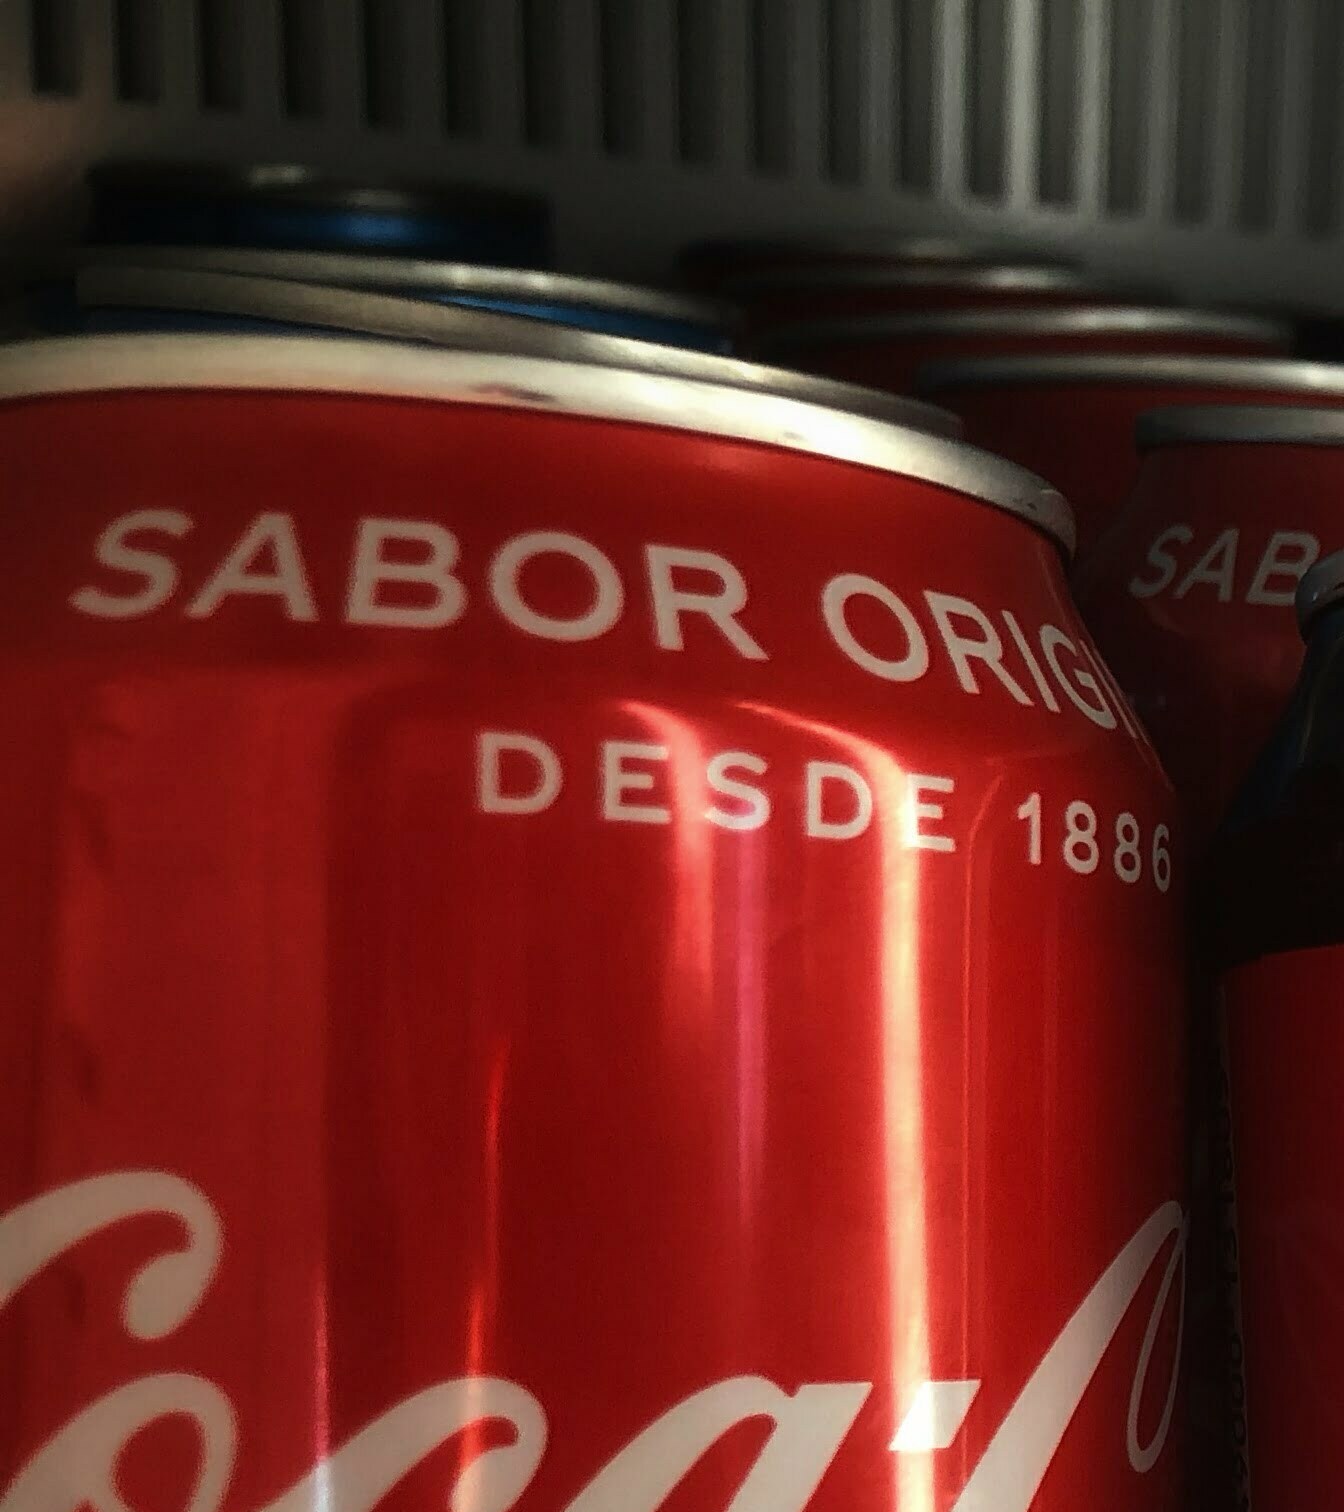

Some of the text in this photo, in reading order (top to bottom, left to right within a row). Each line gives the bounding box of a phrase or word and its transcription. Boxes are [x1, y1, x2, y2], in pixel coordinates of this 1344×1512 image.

[70, 508, 768, 662] SABOR
[476, 729, 1172, 894] DESDE 1886
